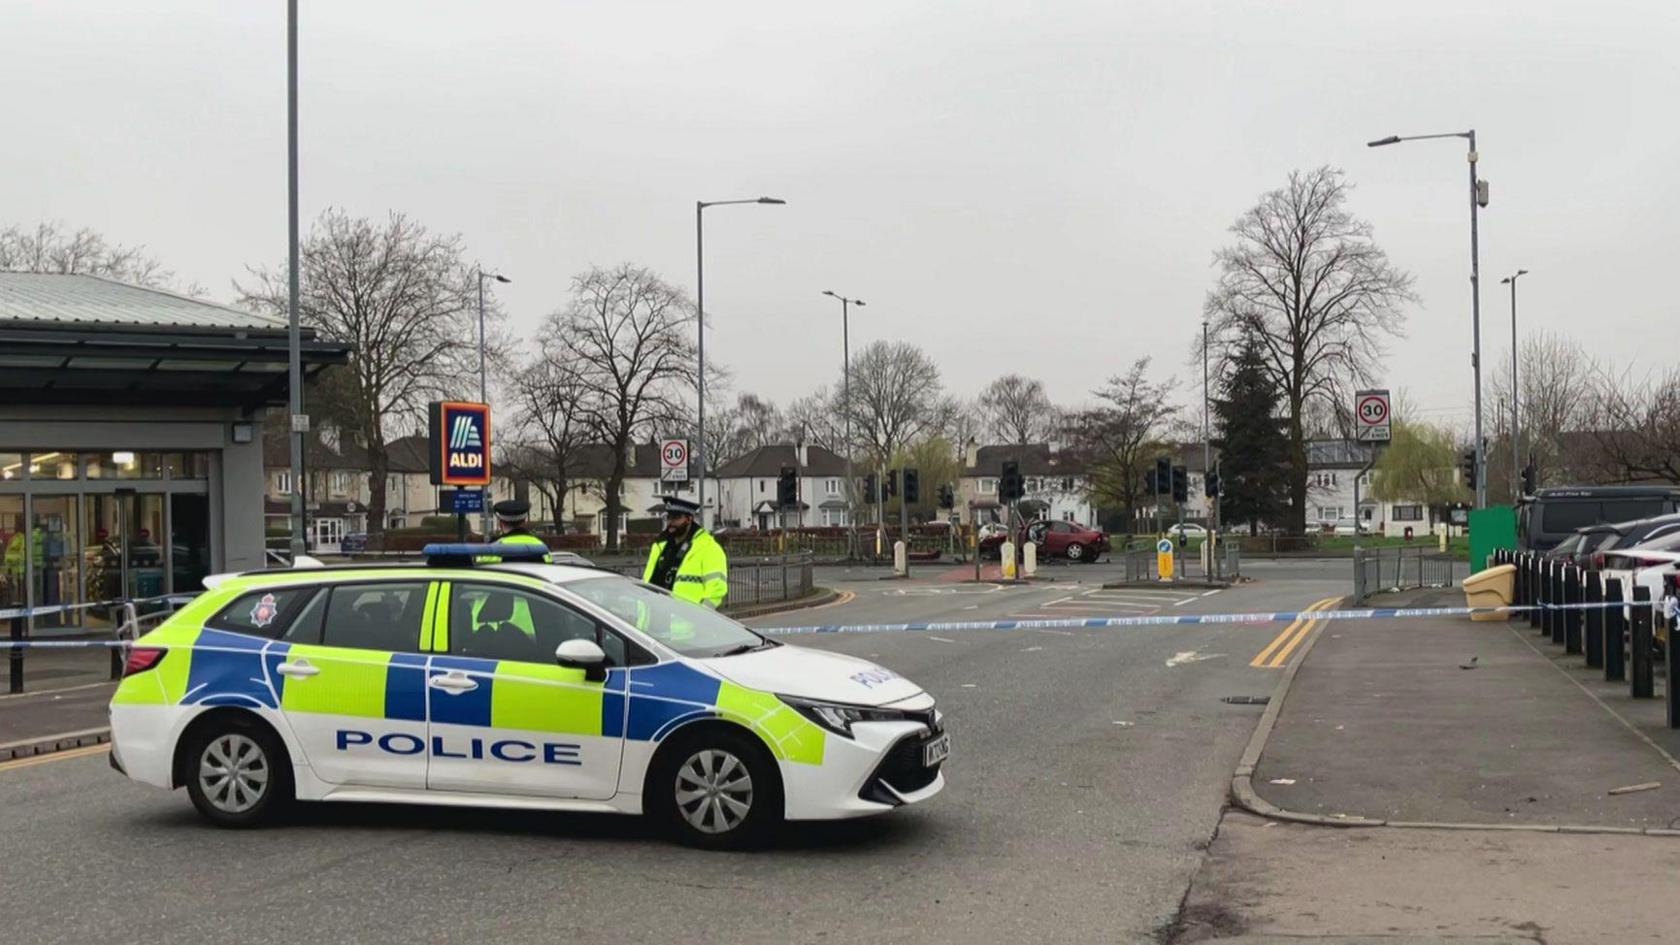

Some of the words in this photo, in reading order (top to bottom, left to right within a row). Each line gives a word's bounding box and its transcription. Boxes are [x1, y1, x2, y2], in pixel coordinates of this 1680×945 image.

[1363, 404, 1383, 417] 30
[449, 452, 483, 468] ALDI
[666, 448, 683, 460] 30
[336, 730, 582, 766] POLICE
